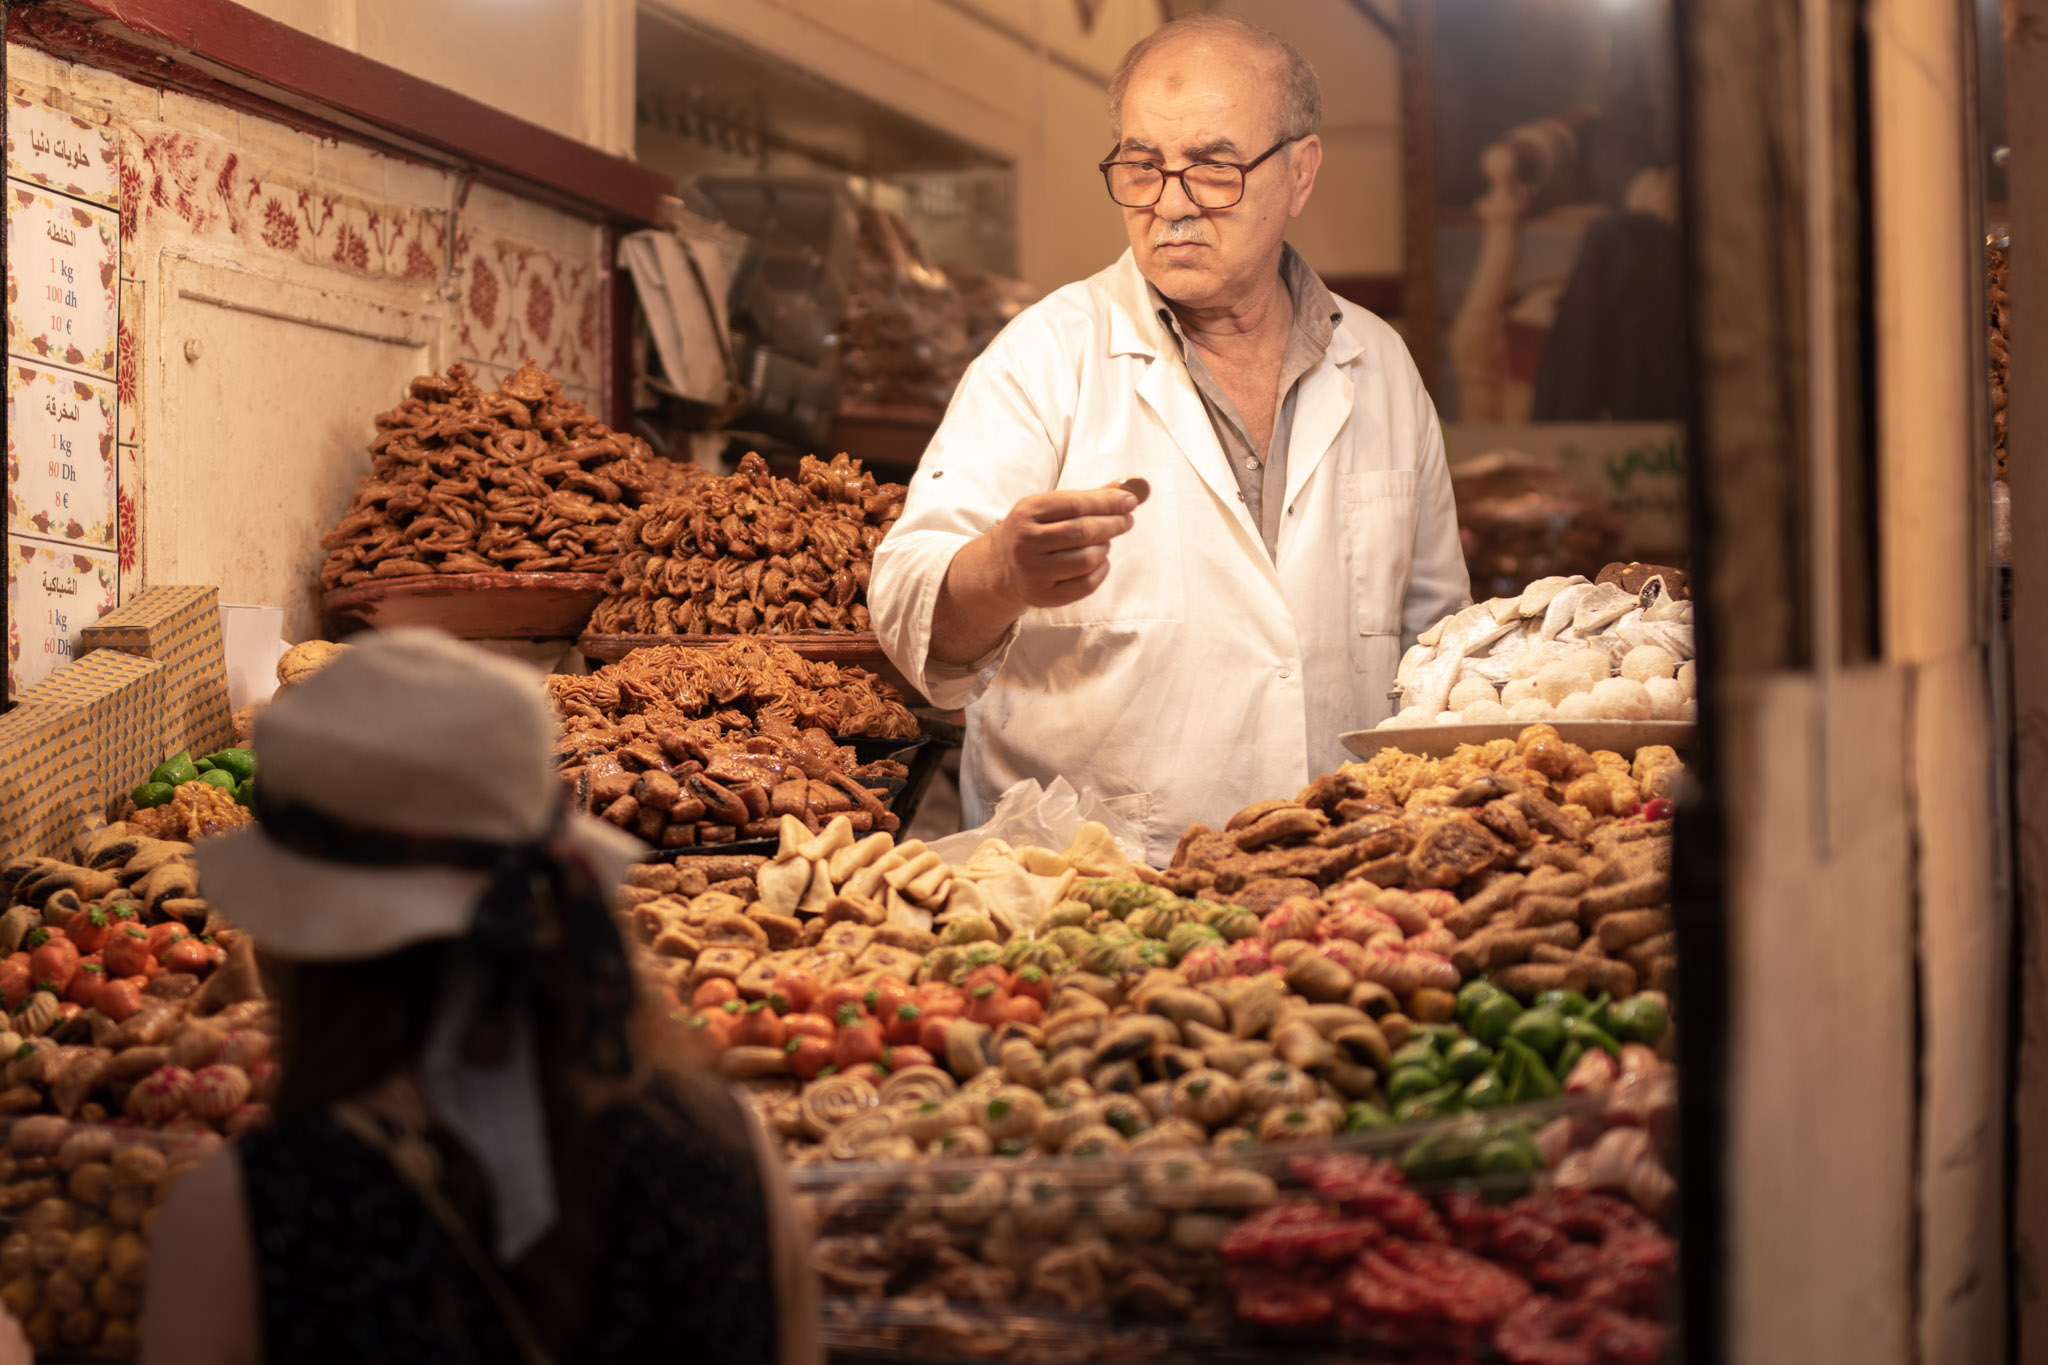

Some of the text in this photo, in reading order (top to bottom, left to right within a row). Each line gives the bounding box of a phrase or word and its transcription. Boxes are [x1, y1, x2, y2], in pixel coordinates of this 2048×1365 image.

[30, 128, 90, 170] حلويات دنيا
[47, 220, 77, 248] الخلطة
[50, 258, 74, 284] 1 kg
[46, 285, 77, 308] 100 dh
[51, 315, 73, 335] 10 €
[45, 395, 80, 423] المخرقة
[51, 433, 72, 457] 1 kg
[48, 460, 76, 482] 80 Dh
[55, 491, 69, 509] 8 €
[42, 570, 78, 598] الشباكية
[47, 608, 68, 632] 1 kg
[44, 637, 72, 656] 60 Dh
